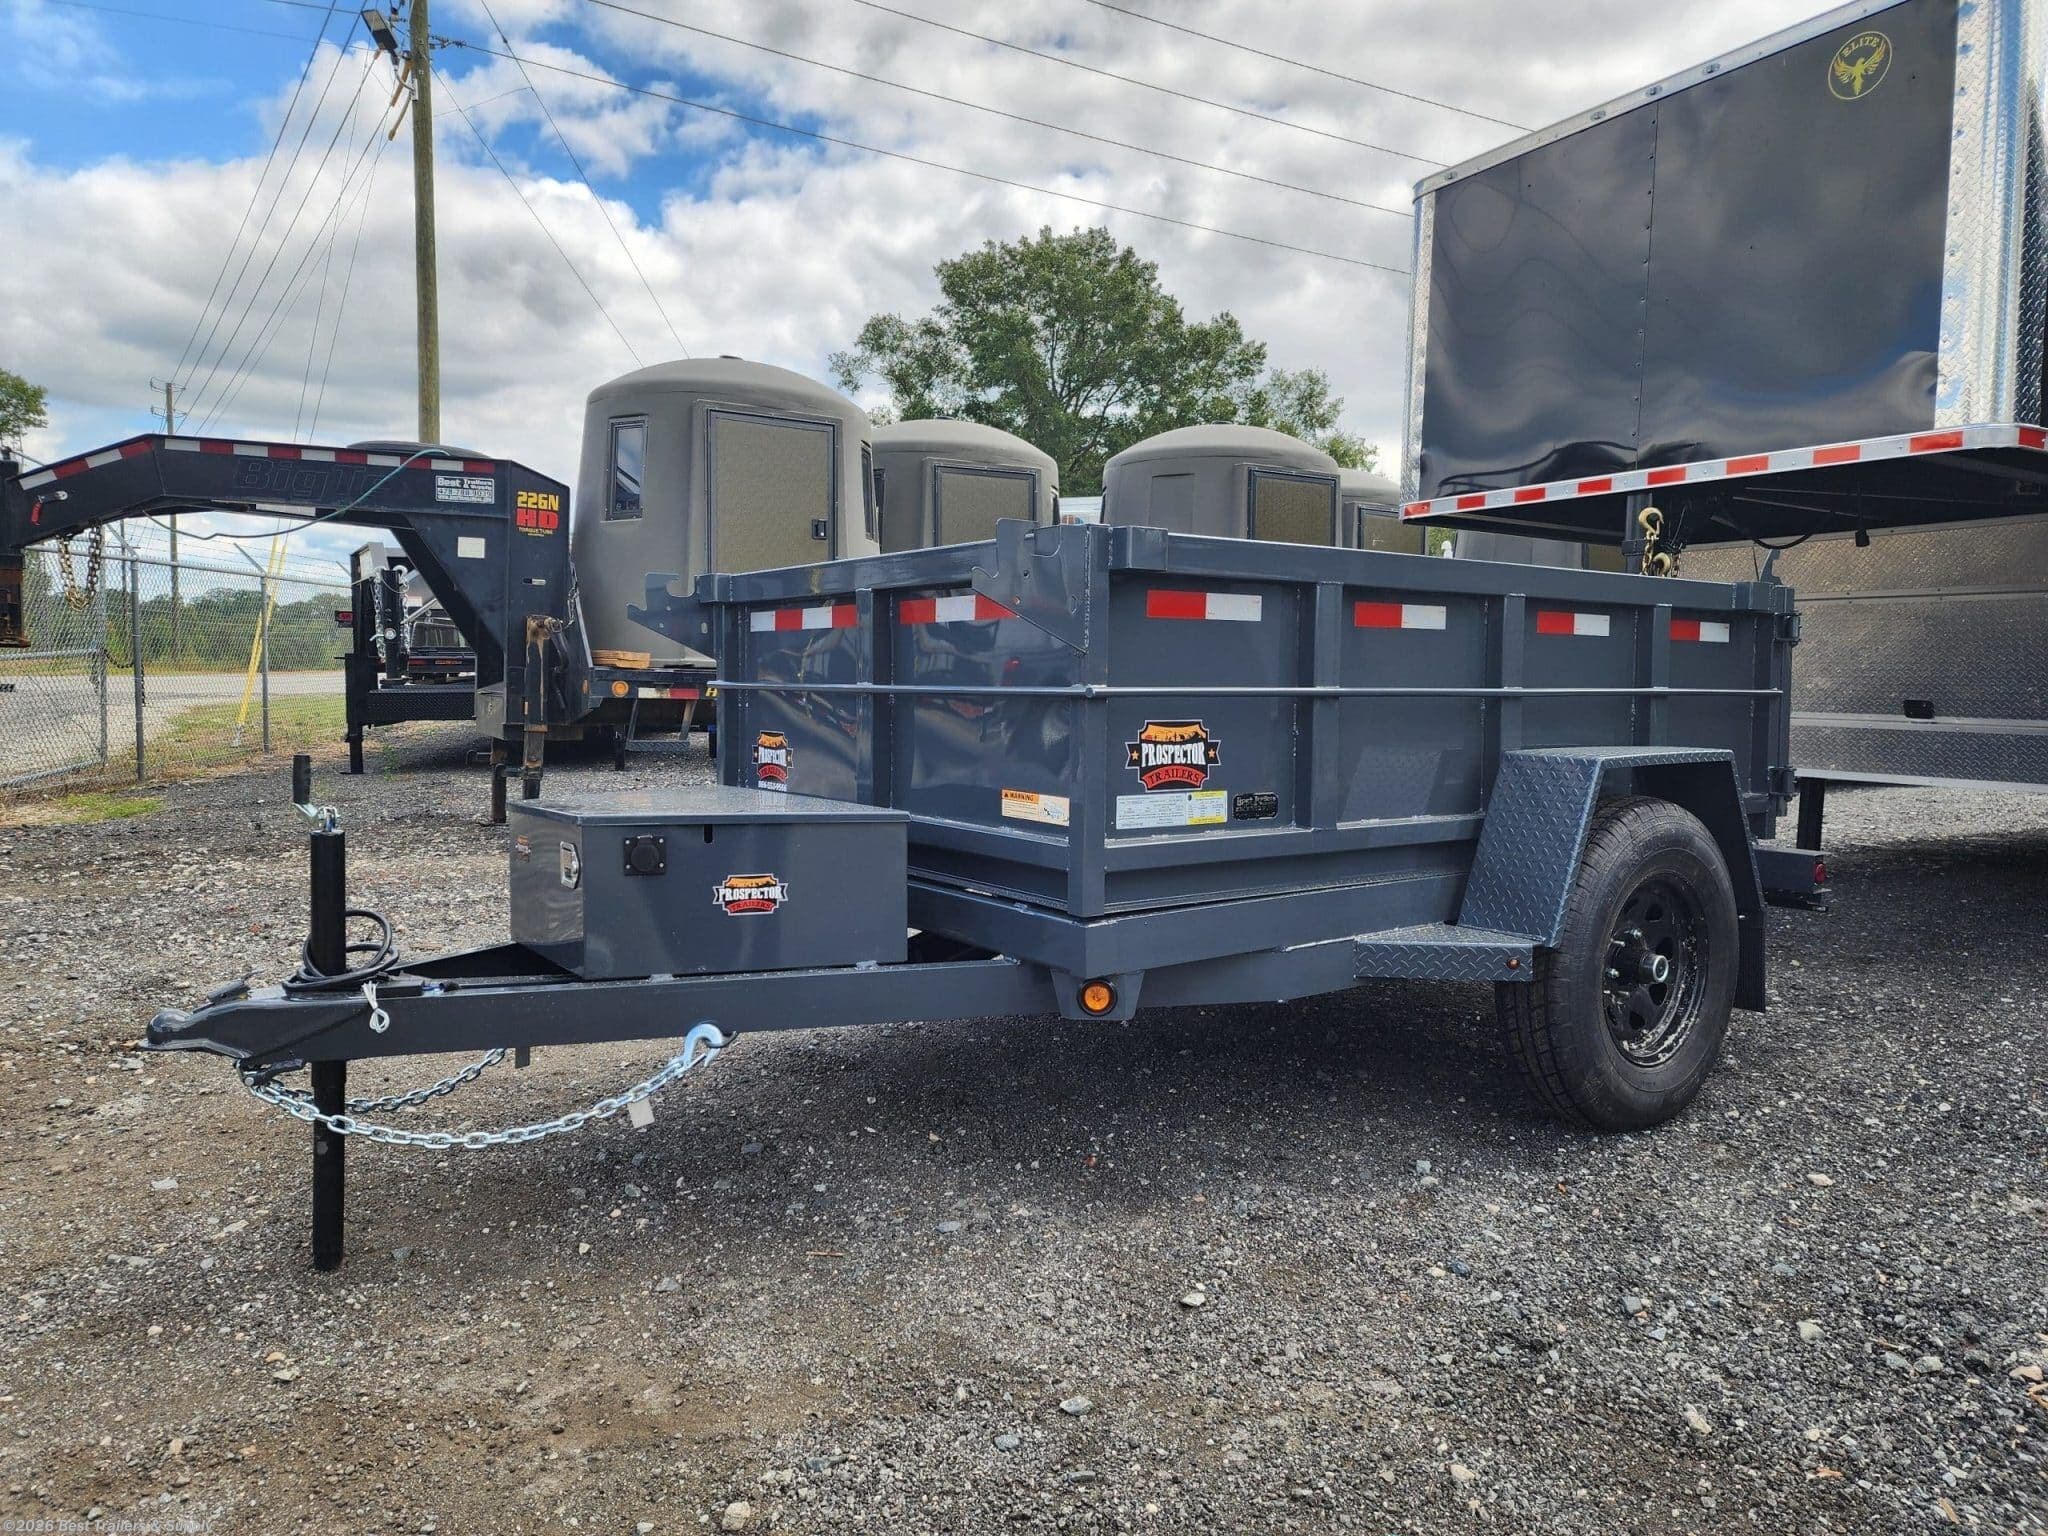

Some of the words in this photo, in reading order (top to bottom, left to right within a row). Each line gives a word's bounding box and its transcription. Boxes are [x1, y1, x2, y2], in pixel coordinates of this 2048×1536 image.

[1841, 36, 1880, 58] ELITE
[233, 457, 328, 499] Big
[437, 478, 462, 488] Best
[517, 491, 559, 511] 226N
[516, 508, 559, 529] HD
[1141, 742, 1206, 768] PROSPECTOR
[1147, 768, 1200, 784] TRAILERS
[718, 886, 783, 902] PROSPECTOR
